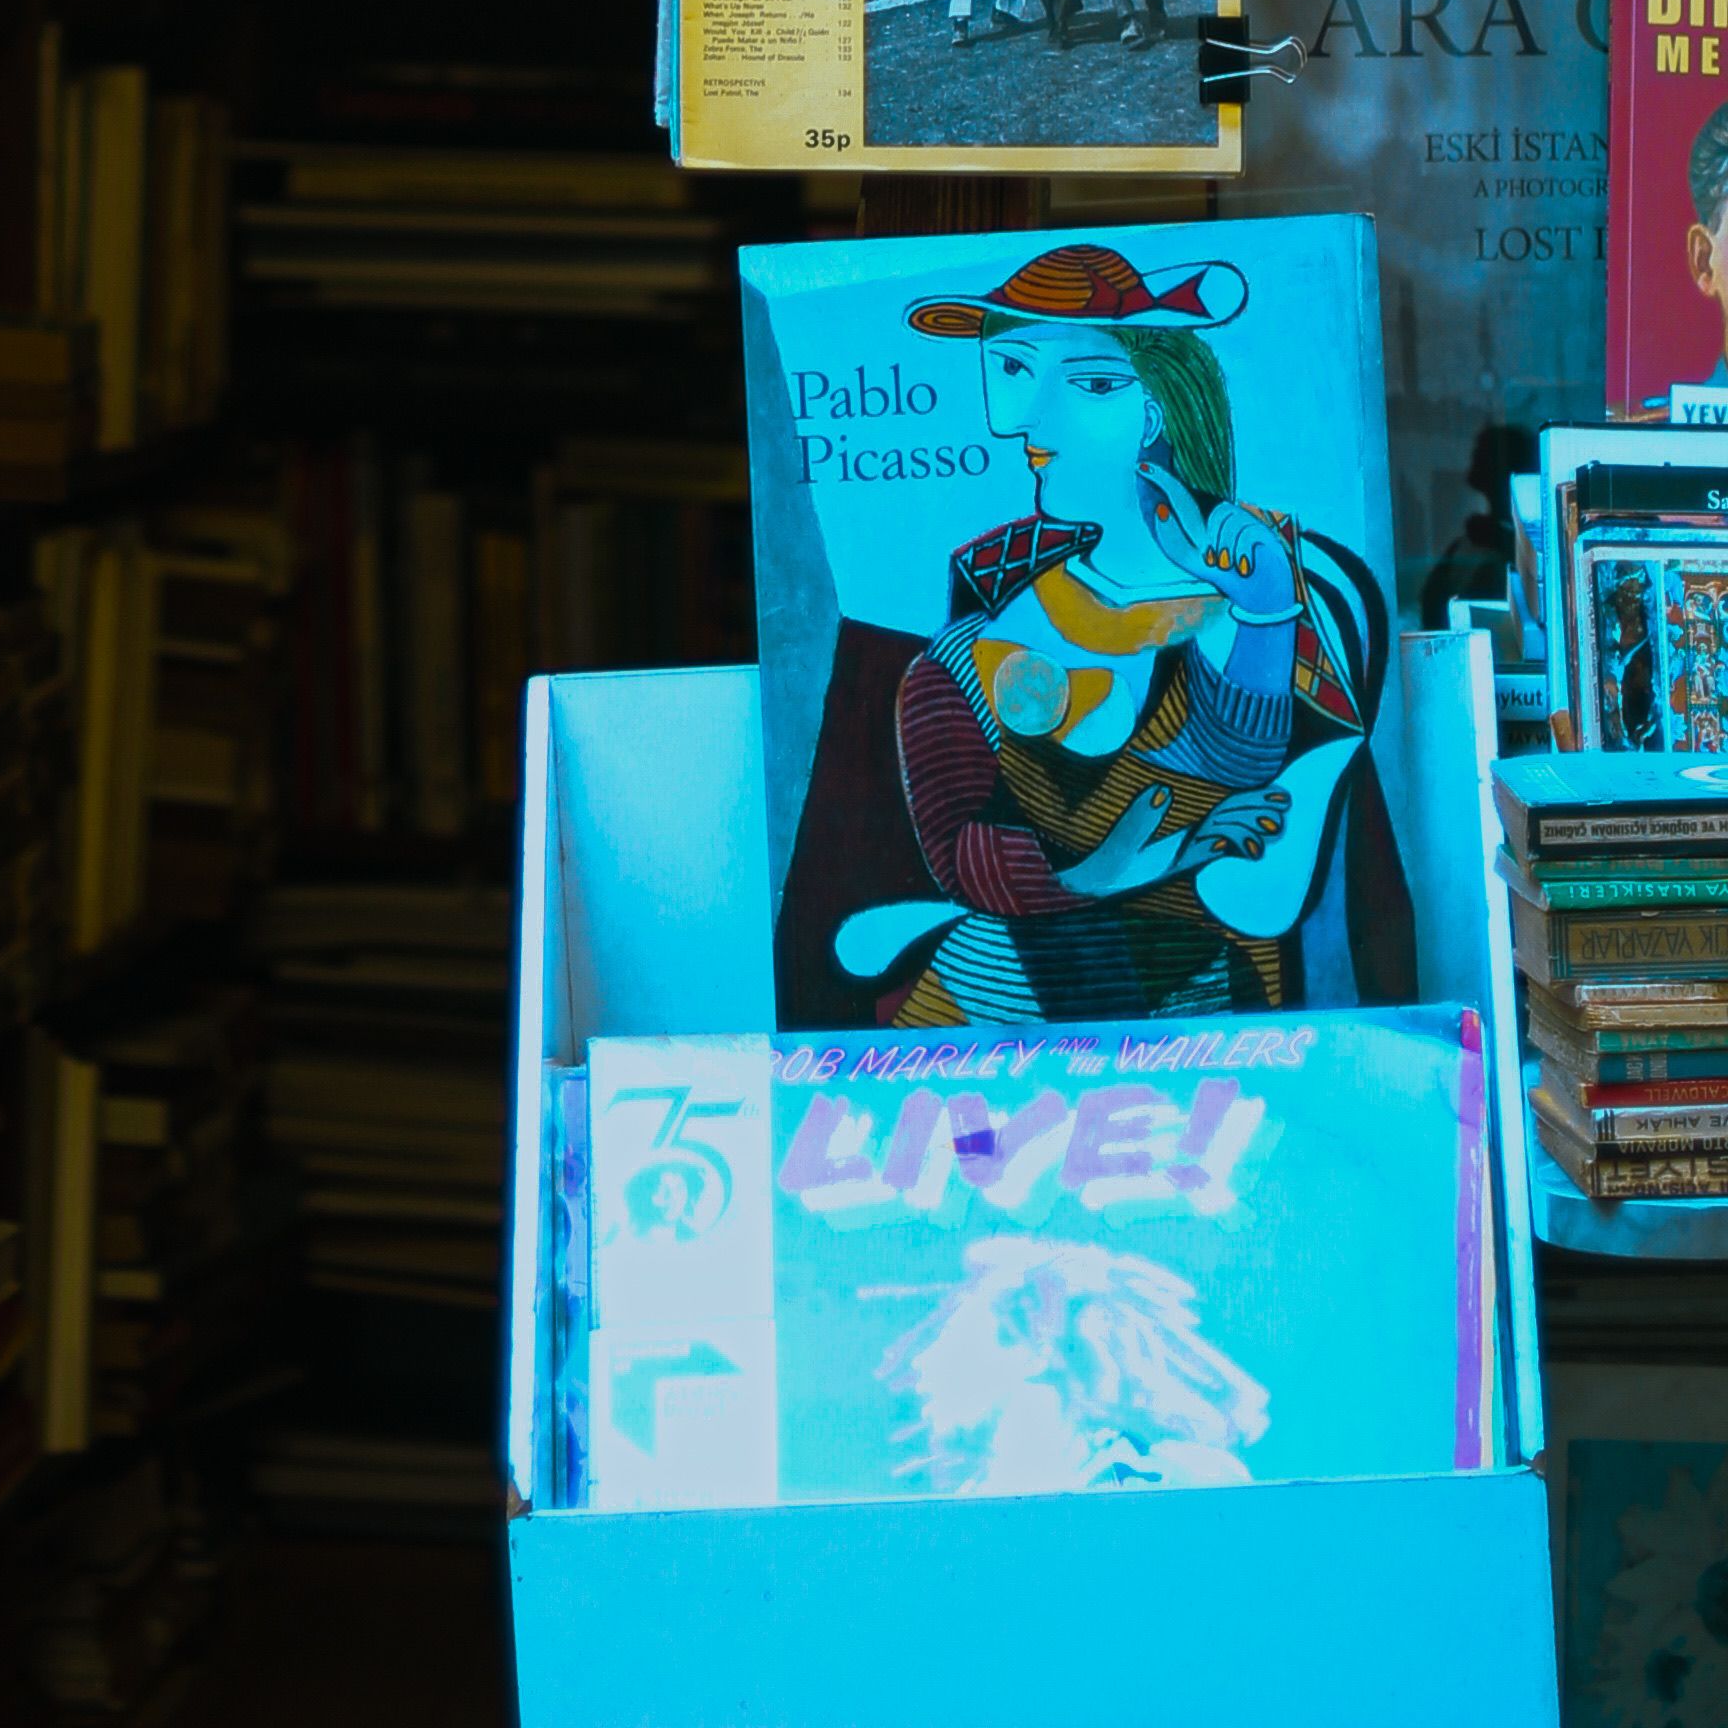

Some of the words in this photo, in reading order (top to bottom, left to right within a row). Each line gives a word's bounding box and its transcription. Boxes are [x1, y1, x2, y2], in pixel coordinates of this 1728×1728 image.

[1655, 33, 1720, 75] ME
[703, 79, 766, 87] RETROSPECTIVE
[803, 129, 851, 155] 35p
[1424, 127, 1501, 164] ESKİ
[1473, 179, 1490, 200] A
[1475, 226, 1583, 263] LOST
[791, 363, 938, 421] Pablo
[794, 434, 990, 486] Picasso
[1497, 688, 1544, 709] ykut
[1543, 821, 1588, 839] ÇAĞIMIZ
[1591, 820, 1648, 838] AÇISINDAN
[1648, 819, 1698, 837] DÜŞÜNCE
[1568, 883, 1696, 899] KLASİKLERİ
[1579, 927, 1694, 960] YAZARLAR
[1050, 1036, 1101, 1055] AND
[1114, 1025, 1315, 1074] WAILERS
[848, 1038, 1045, 1083] MARLEY
[1065, 1054, 1110, 1077] THE
[1643, 1085, 1728, 1102] CALDWELL
[779, 1077, 1262, 1204] LIVE!
[1617, 1139, 1695, 1154] MORAVIA
